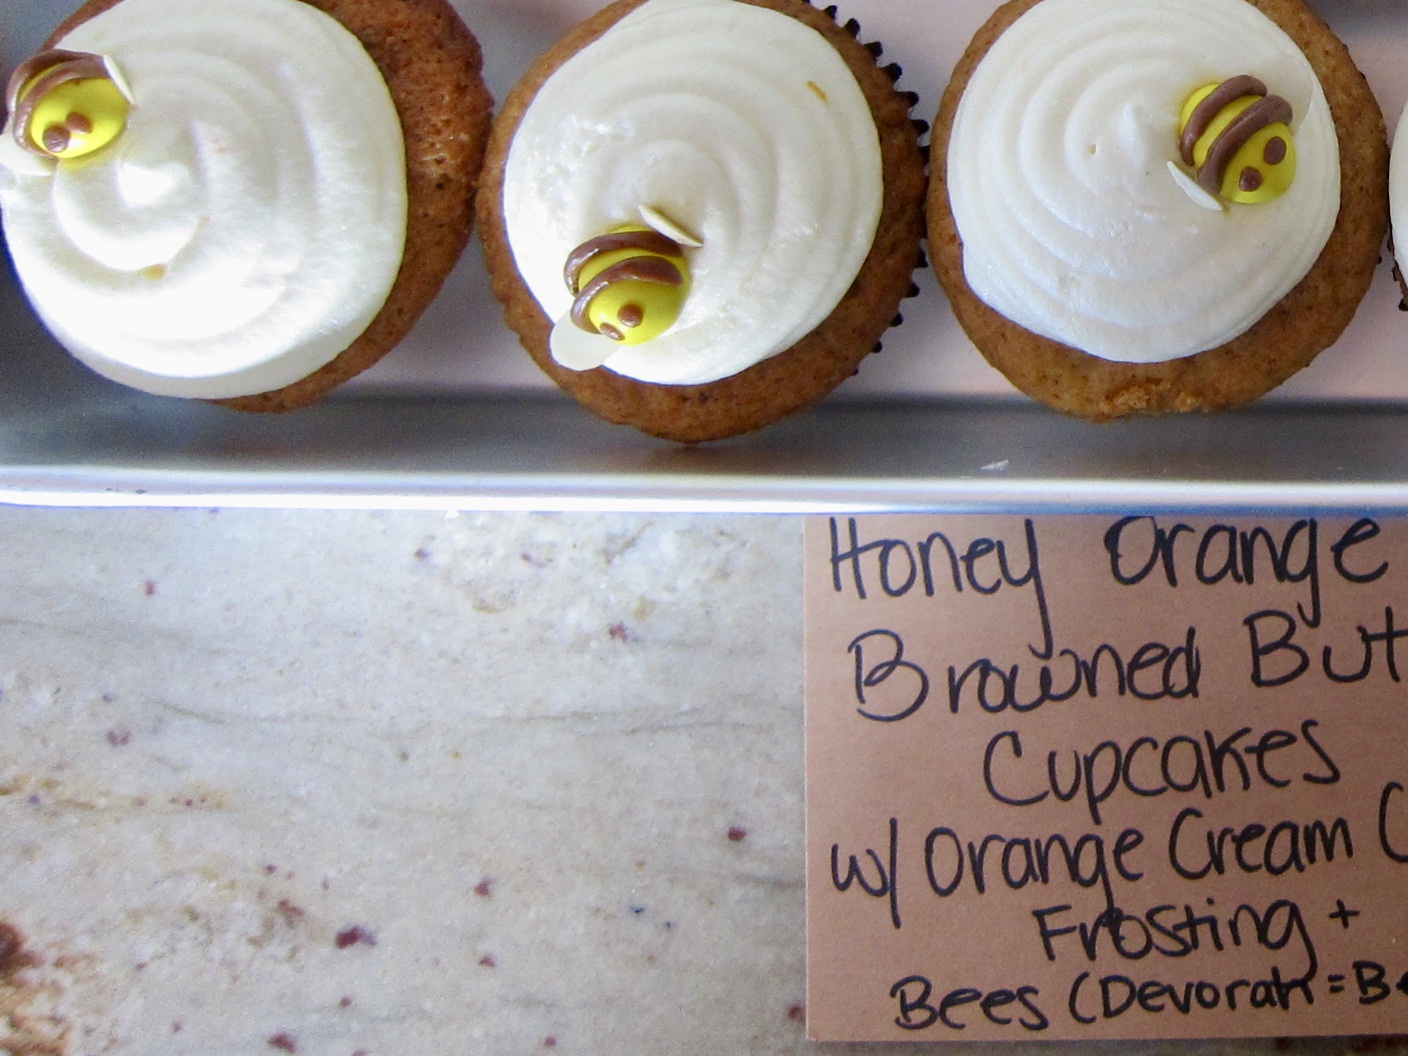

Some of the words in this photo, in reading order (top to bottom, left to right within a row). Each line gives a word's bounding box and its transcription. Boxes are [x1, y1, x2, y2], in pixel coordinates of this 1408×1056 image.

[829, 517, 1053, 658] Honey
[1104, 516, 1388, 629] Orange
[847, 625, 1200, 721] Browned
[983, 720, 1340, 823] Cupcakes
[830, 818, 900, 928] w/
[925, 825, 1144, 934] Orange
[1167, 808, 1352, 880] Cream
[1033, 897, 1317, 979] Frosting
[1328, 900, 1360, 928] +
[891, 975, 1049, 1031] Bees
